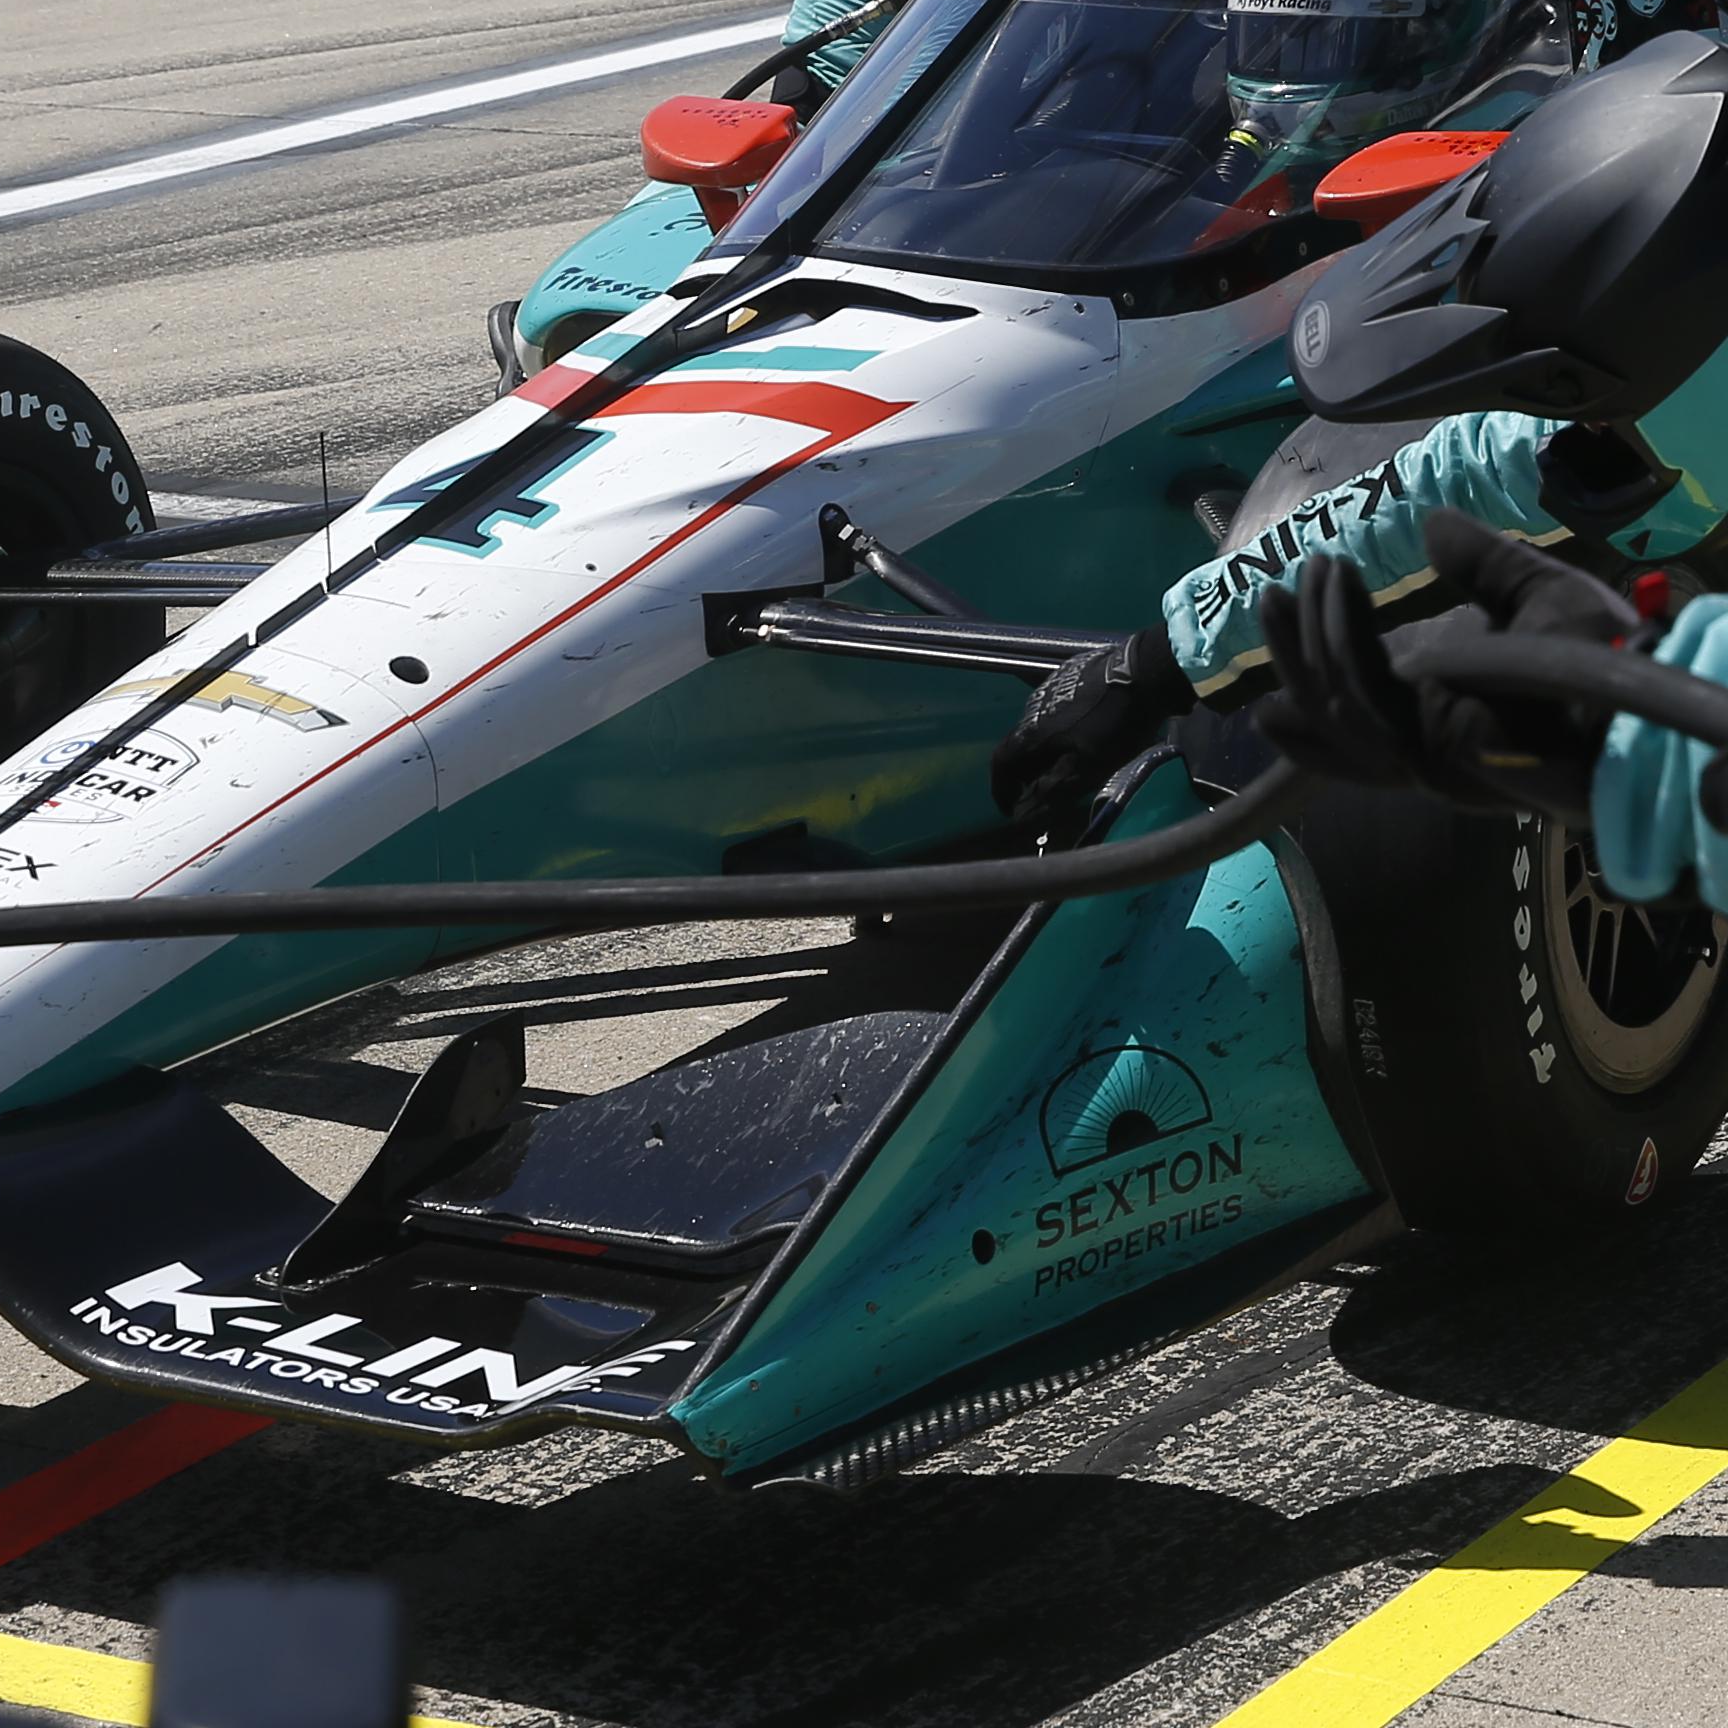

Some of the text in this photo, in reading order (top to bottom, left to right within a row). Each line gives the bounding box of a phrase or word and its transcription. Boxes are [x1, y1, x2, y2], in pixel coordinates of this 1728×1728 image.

[1301, 311, 1325, 361] BELL
[1034, 1131, 1245, 1250] SEXTON
[1033, 1192, 1243, 1298] PROPERTIES
[70, 1296, 373, 1397] INSULATORS
